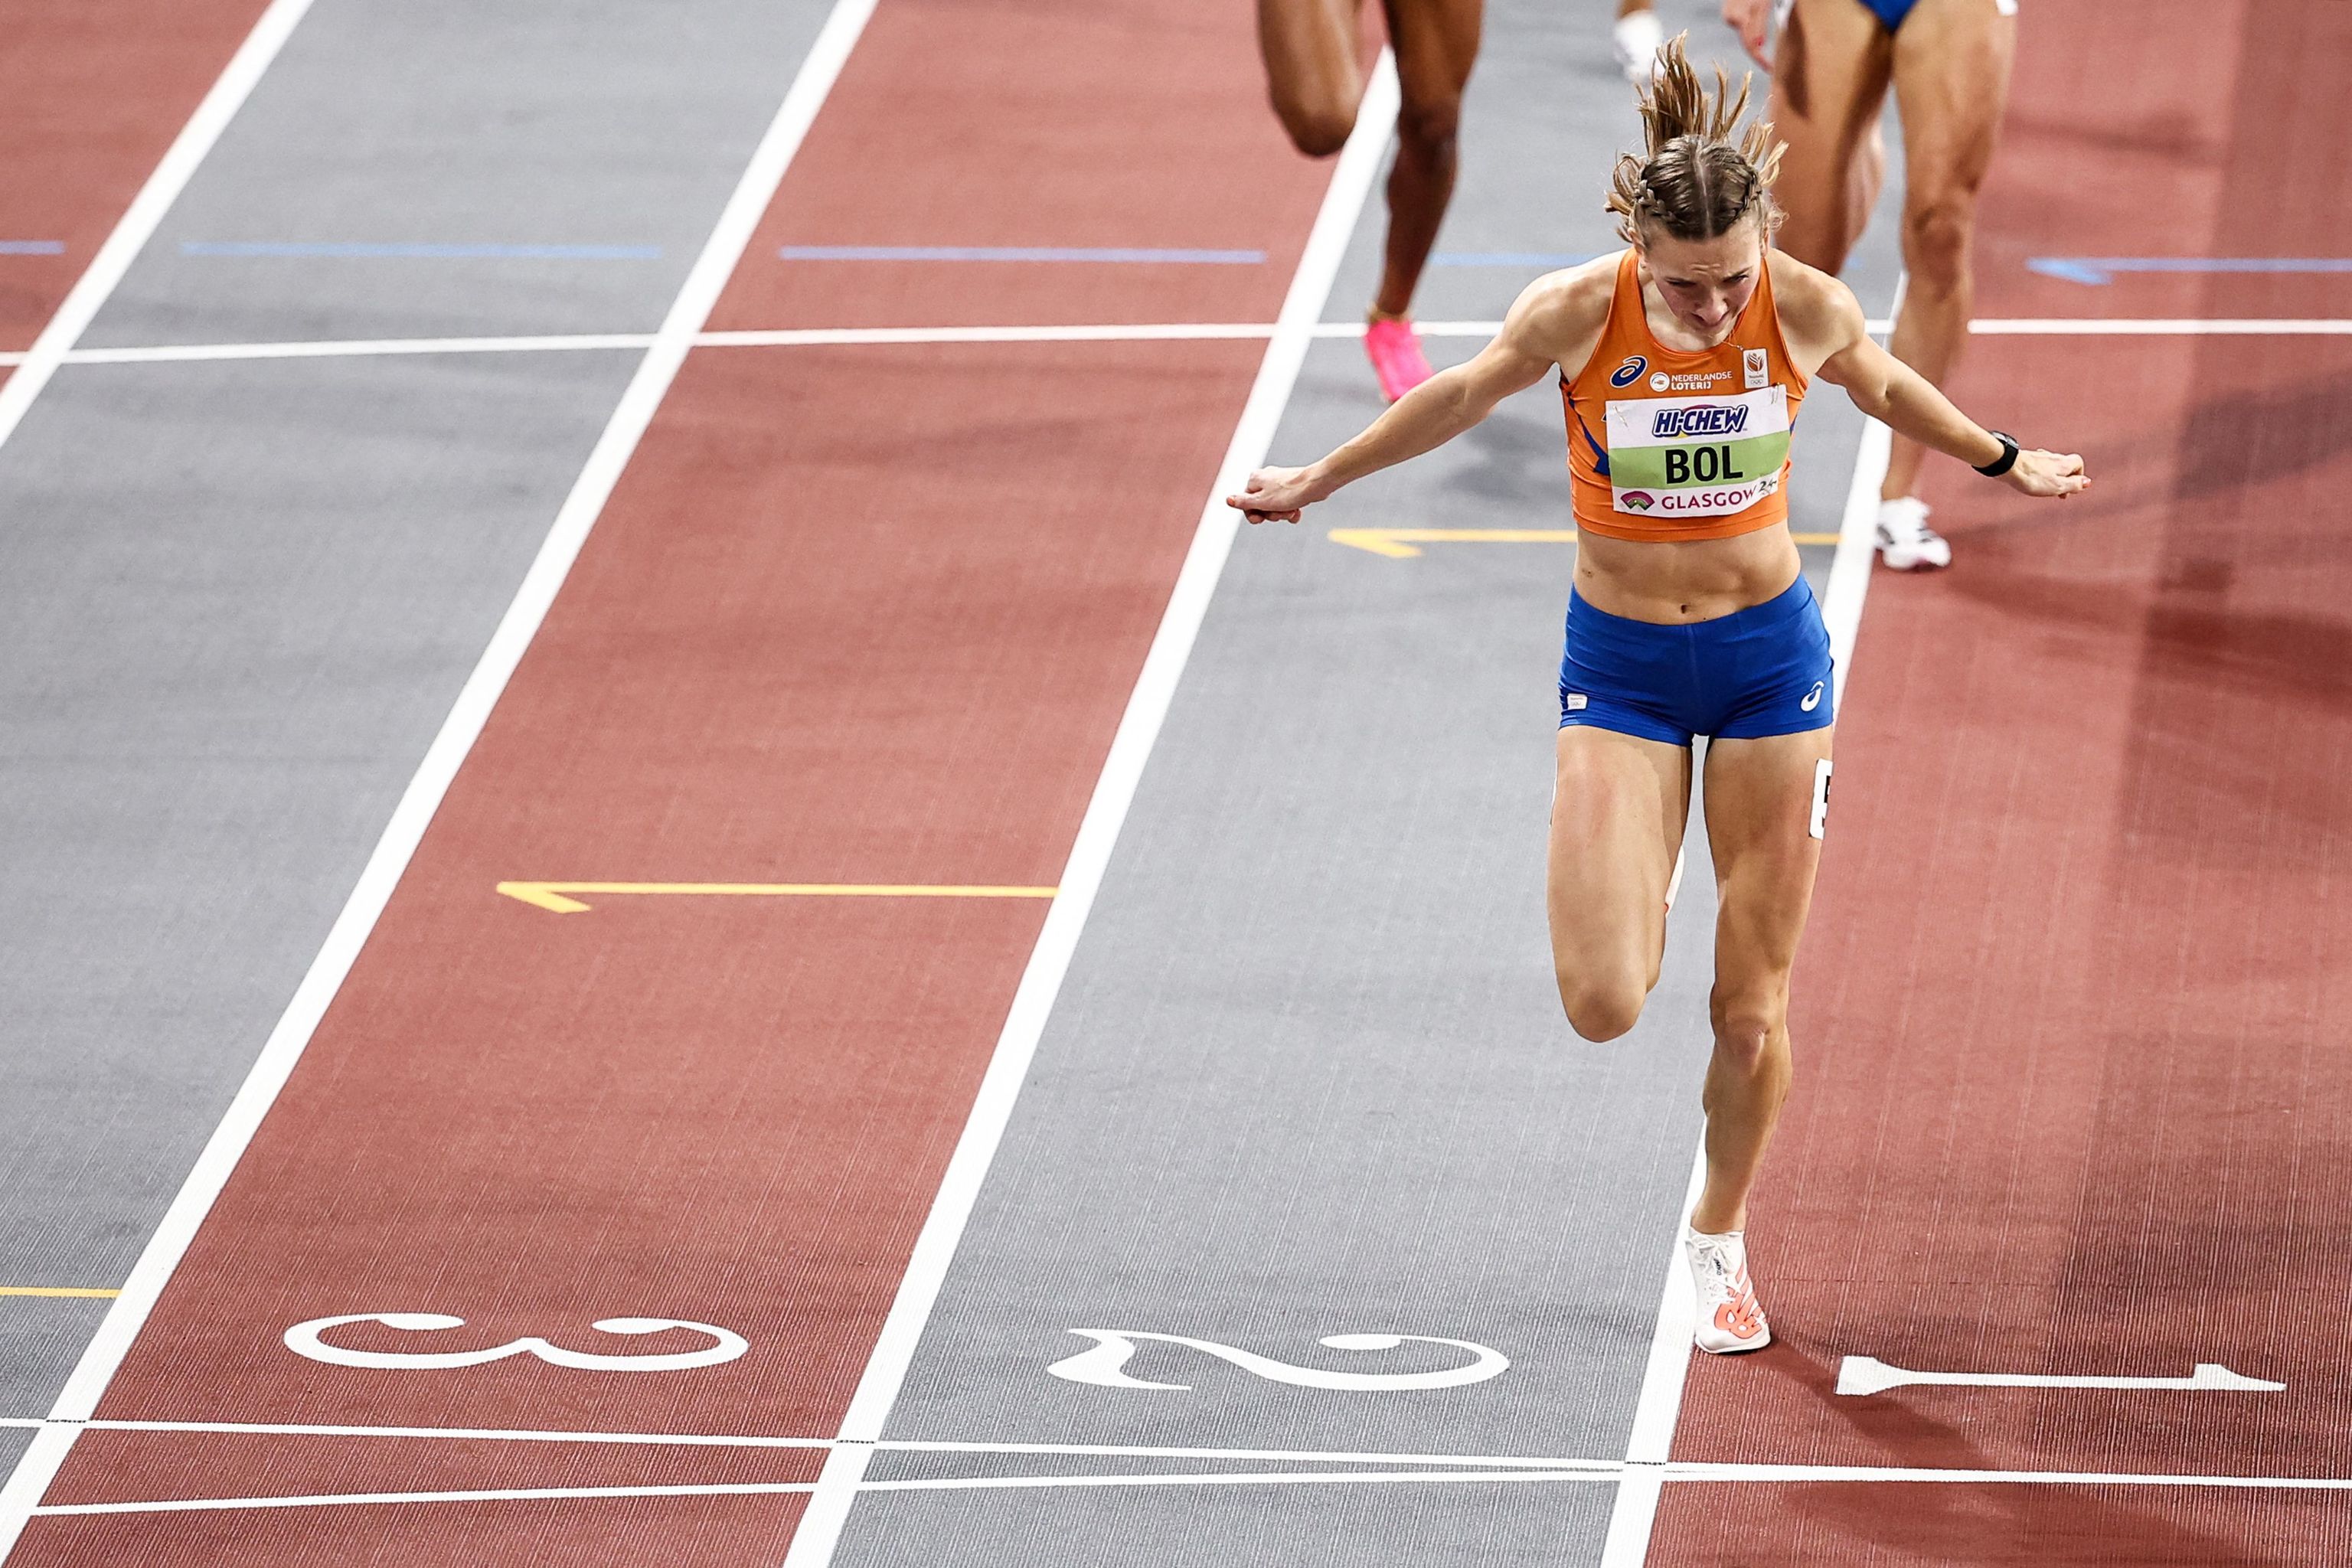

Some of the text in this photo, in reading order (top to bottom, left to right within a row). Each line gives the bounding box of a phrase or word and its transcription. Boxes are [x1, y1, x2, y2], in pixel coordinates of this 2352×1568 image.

[1671, 371, 1733, 382] NEDERLANDSE
[1671, 381, 1711, 390] LOTERIJ
[1652, 405, 1747, 437] HI-CHEW
[1665, 446, 1743, 485] BOL
[1661, 485, 1756, 510] GLASGOW
[284, 1312, 750, 1371] 3
[1047, 1328, 1510, 1391] 2
[1836, 1355, 2287, 1396] 1
